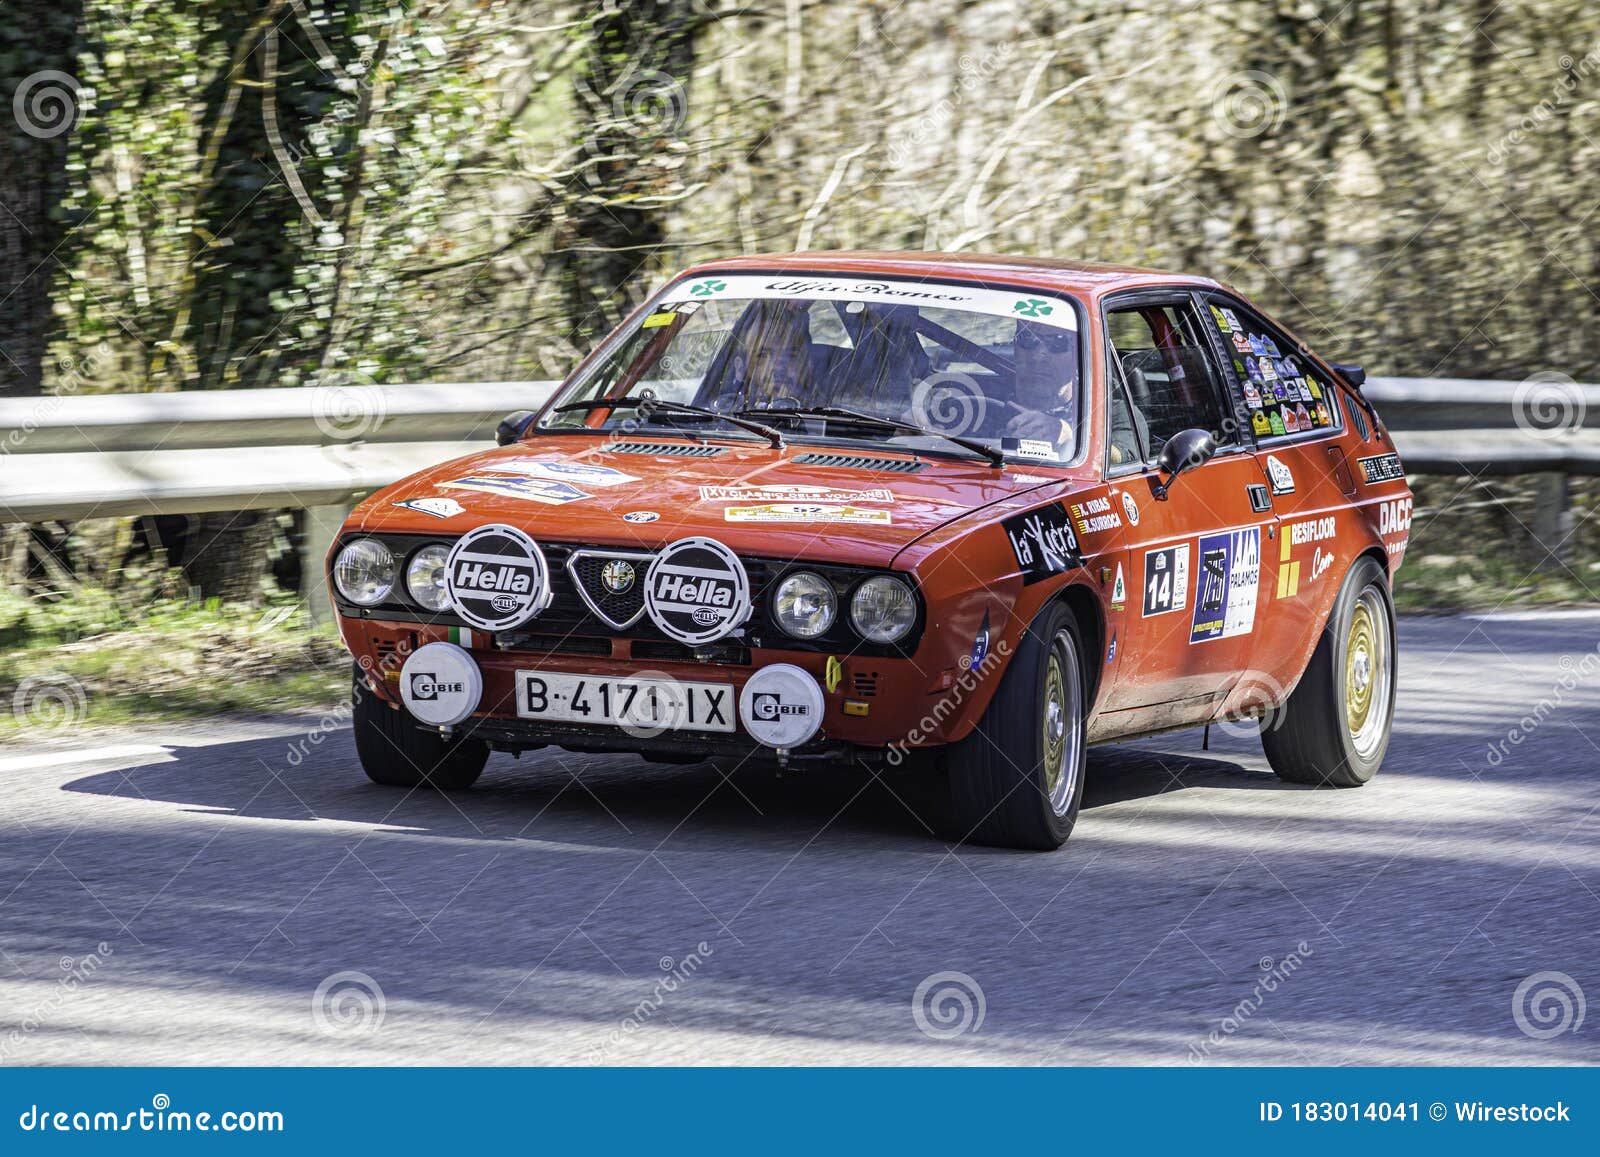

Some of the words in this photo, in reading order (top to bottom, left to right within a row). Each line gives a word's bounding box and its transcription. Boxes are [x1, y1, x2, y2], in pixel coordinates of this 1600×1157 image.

[852, 282, 969, 302] Romeo
[1291, 517, 1336, 545] RESIFLOOR
[456, 562, 531, 594] Hella
[656, 575, 733, 607] Hella
[1148, 571, 1171, 610] 14
